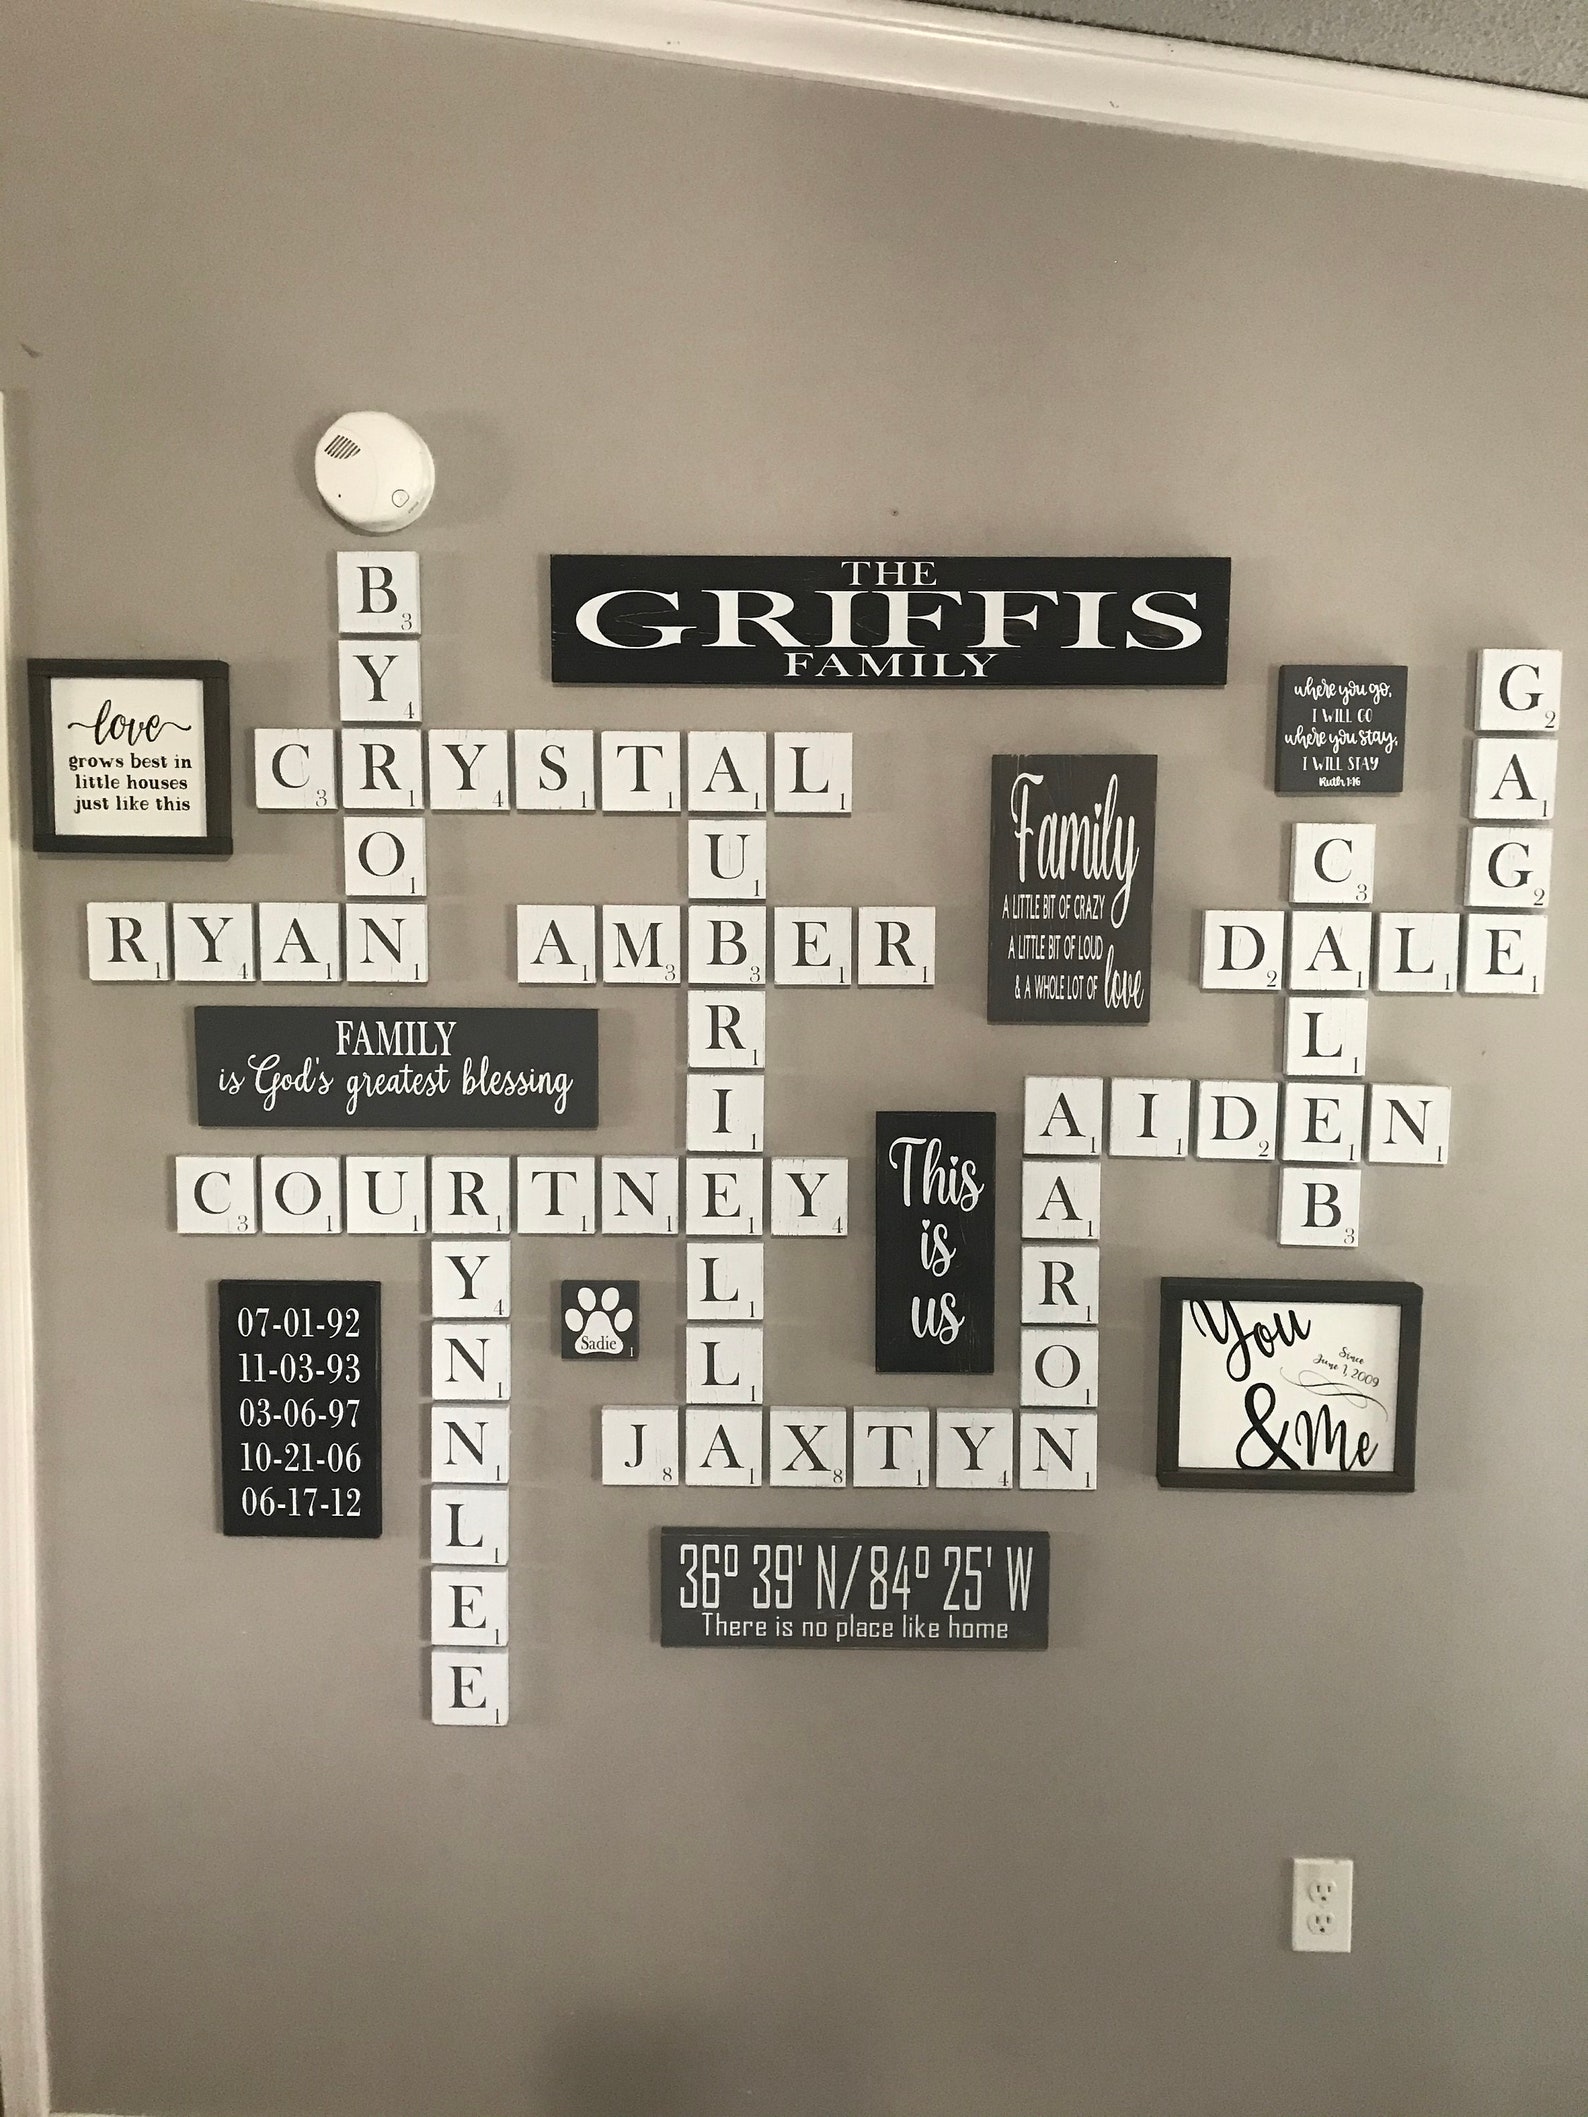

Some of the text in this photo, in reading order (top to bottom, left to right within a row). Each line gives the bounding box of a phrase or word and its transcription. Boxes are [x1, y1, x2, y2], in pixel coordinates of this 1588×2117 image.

[841, 561, 936, 585] THE
[401, 613, 412, 631] 3
[575, 589, 1201, 650] GRIFFIS
[784, 652, 997, 676] FAMILY
[1294, 676, 1391, 705] where you go,
[67, 699, 191, 746] love
[403, 701, 415, 719] 4
[1312, 707, 1372, 722] I WILL GO
[1545, 711, 1556, 729] 2
[1284, 724, 1398, 754] where you stay,
[68, 752, 193, 771] grows best in
[271, 743, 829, 794] CRYSTAL
[352, 566, 406, 964] BYRON
[1302, 756, 1378, 770] I WILL STAY
[75, 773, 187, 789] little houses
[1318, 775, 1360, 786] Ruth 1:16
[74, 795, 190, 814] just like this
[316, 789, 327, 807] 3
[492, 790, 504, 807] 4
[1485, 664, 1543, 975] GAGE
[1010, 772, 1139, 928] Family
[1001, 893, 1105, 919] A LITTLE BIT OF CRAZY
[1356, 884, 1367, 902] 3
[1534, 888, 1545, 906] 2
[107, 916, 406, 964] RYAN
[530, 919, 917, 968] AMBER
[1007, 934, 1103, 960] A LITTLE BIT OF LOUD
[1217, 925, 1522, 975] DALE
[237, 962, 248, 979] 4
[665, 964, 676, 981] 3
[750, 966, 760, 983] 3
[1014, 944, 1144, 1008] & A WHOLE LOT OF love
[1266, 970, 1277, 987] 2
[335, 1020, 456, 1055] FAMILY
[1301, 838, 1353, 1228] CALEB
[218, 1053, 573, 1115] is God's greatest blessing
[699, 746, 751, 1469] AUBRIELLA
[1038, 1092, 1432, 1145] AIDEN
[1258, 1140, 1269, 1157] 2
[888, 1136, 984, 1211] This
[193, 1170, 830, 1218] COURTNEY
[237, 1214, 248, 1232] 3
[831, 1217, 843, 1233] 4
[1343, 1228, 1355, 1245] 3
[920, 1219, 956, 1276] is
[1032, 1092, 1087, 1472] AARON
[494, 1299, 504, 1315] 4
[911, 1292, 965, 1344] us
[237, 1307, 359, 1338] 07-01-92
[581, 1335, 616, 1349] Sadie
[1190, 1300, 1311, 1382] You
[1338, 1347, 1364, 1365] Since
[238, 1353, 360, 1383] 11-03-93
[1313, 1353, 1339, 1371] June
[1351, 1368, 1380, 1388] 2009
[239, 1398, 359, 1428] 03-06-97
[1236, 1383, 1379, 1471] & Me
[443, 1171, 490, 1709] RYNNLEE
[623, 1423, 1079, 1472] JAXTYN
[240, 1442, 360, 1472] 10-21-06
[662, 1467, 672, 1482] 8
[833, 1468, 843, 1484] 8
[998, 1470, 1009, 1487] 4
[241, 1486, 360, 1516] 06-17-12
[752, 1544, 802, 1608] 39'
[943, 1546, 991, 1610] 25'
[1006, 1546, 1032, 1611] W
[701, 1612, 1007, 1642] There is no place like home
